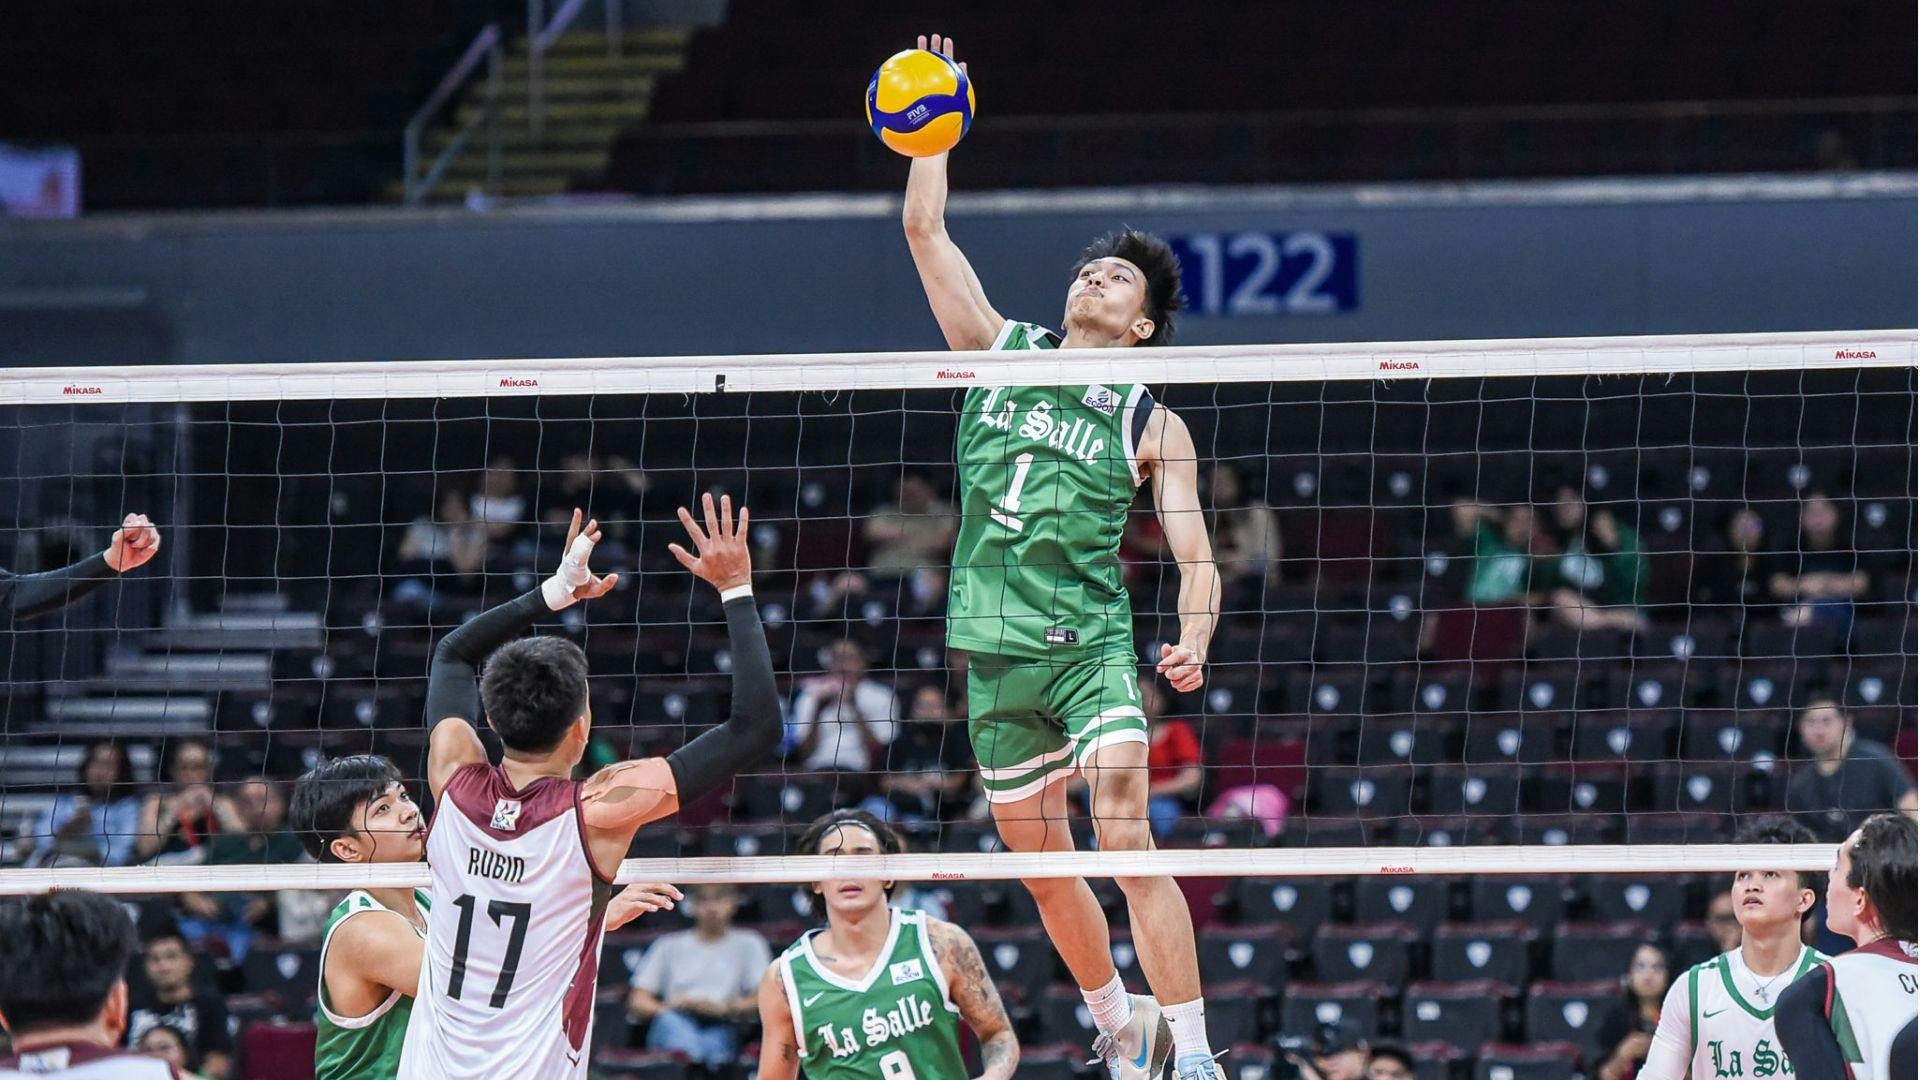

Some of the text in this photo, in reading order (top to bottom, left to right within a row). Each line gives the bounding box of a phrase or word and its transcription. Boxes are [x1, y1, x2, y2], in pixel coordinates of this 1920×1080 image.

[907, 104, 927, 120] FIVB
[1190, 233, 1337, 313] 122
[978, 386, 1104, 466] La Salle
[999, 452, 1034, 513] 1
[1121, 672, 1136, 701] 1
[468, 847, 525, 884] RUBIN
[447, 893, 531, 1009] 17
[818, 994, 934, 1058] La Salle
[1707, 1039, 1744, 1078] La
